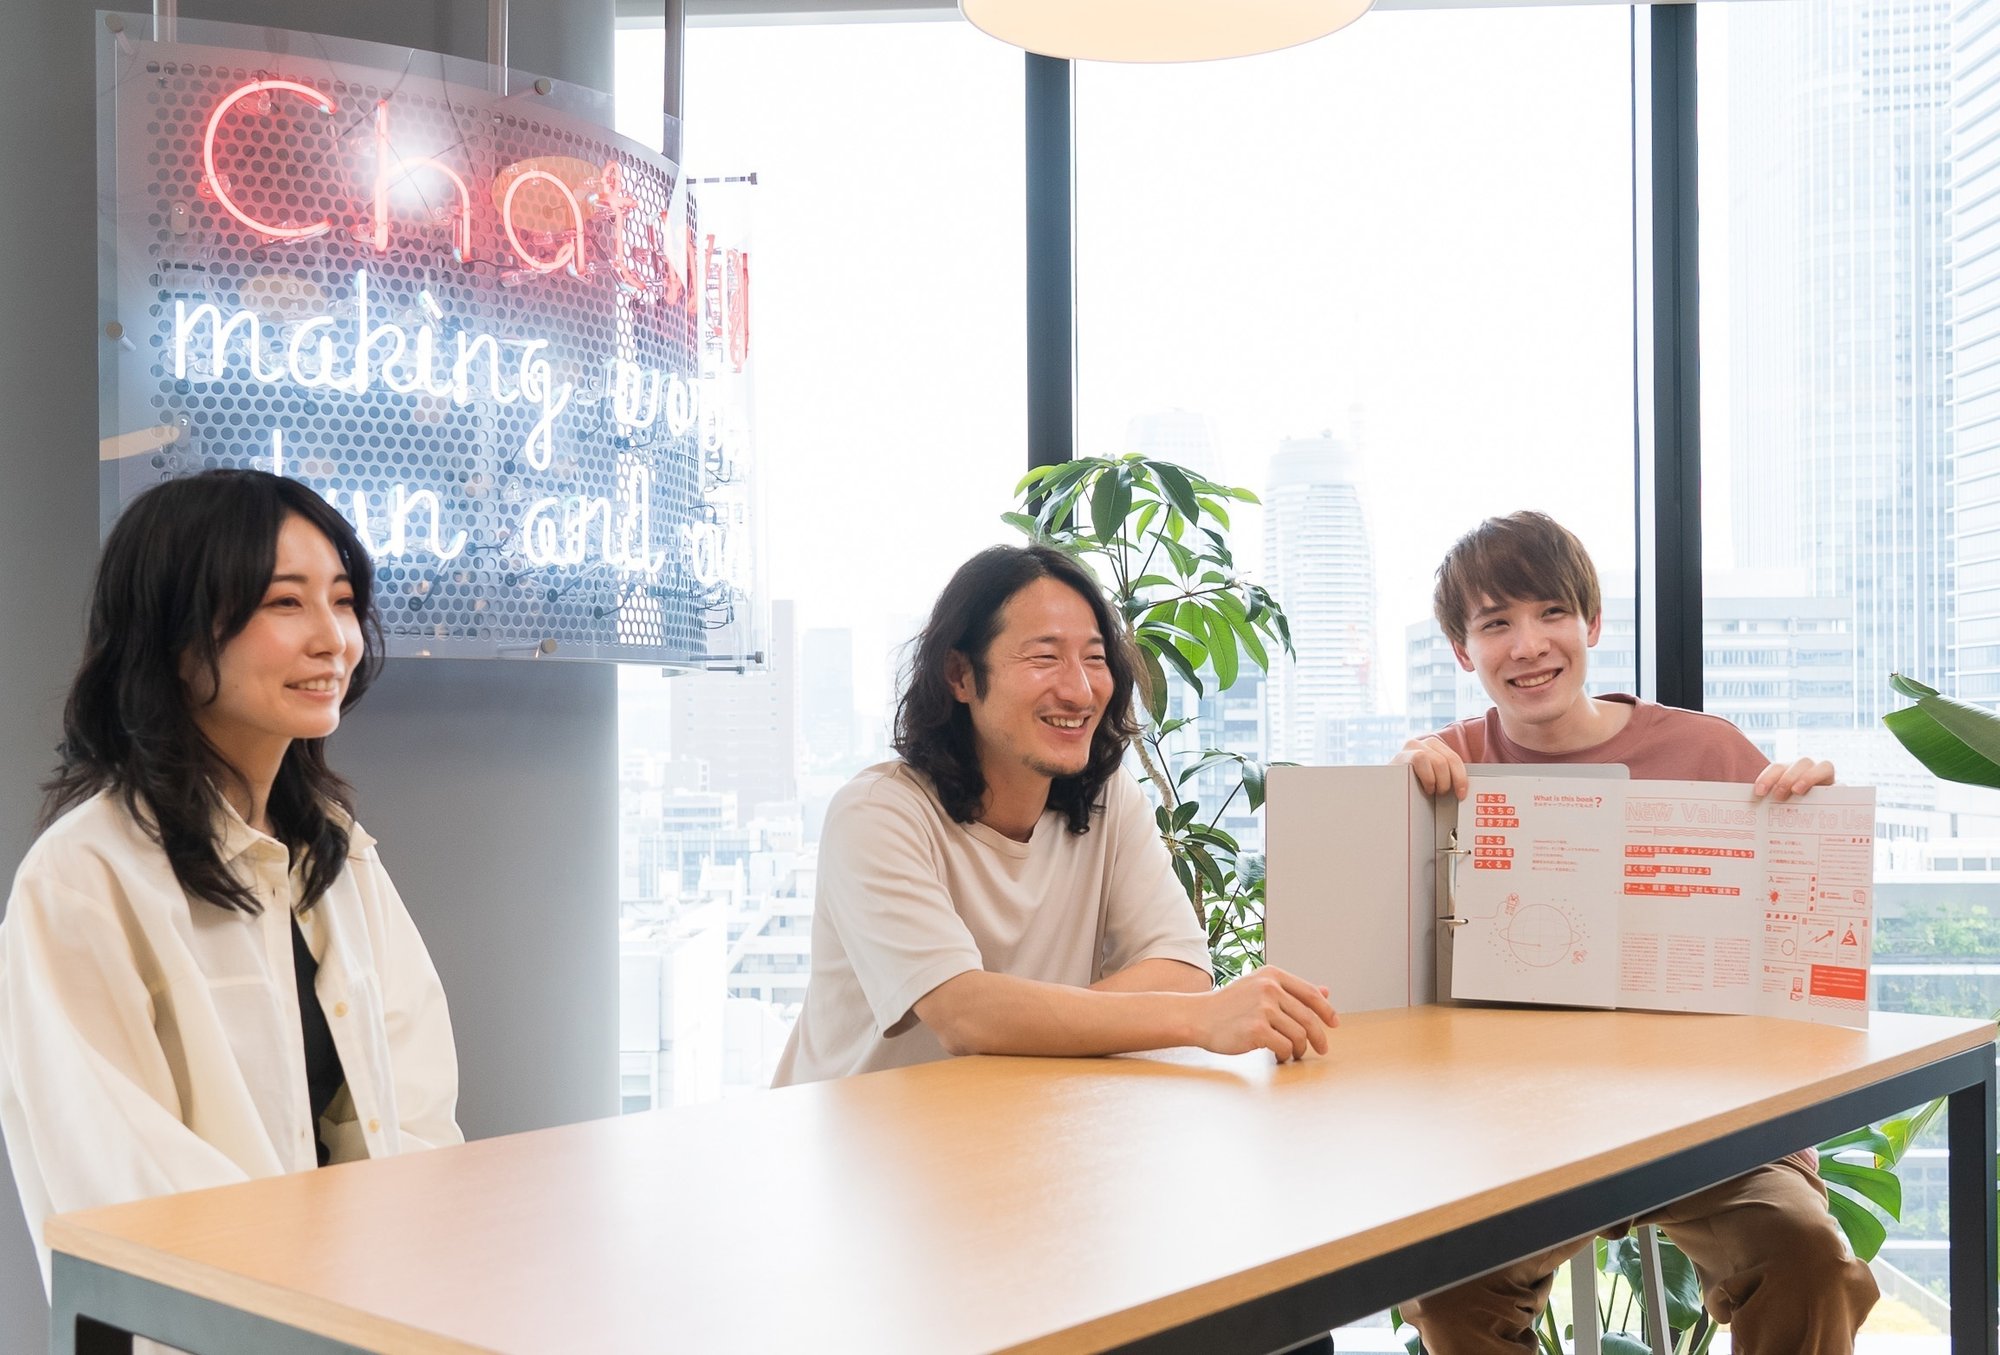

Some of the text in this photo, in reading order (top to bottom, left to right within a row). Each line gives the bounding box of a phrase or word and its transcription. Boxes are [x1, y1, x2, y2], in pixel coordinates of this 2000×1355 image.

[173, 268, 570, 471] making
[523, 464, 664, 574] and
[1533, 794, 1552, 802] What
[1561, 795, 1575, 803] this
[1477, 807, 1514, 815] 私たちの
[1625, 802, 1757, 827] New Values
[1768, 807, 1814, 828] How
[1819, 810, 1838, 829] to
